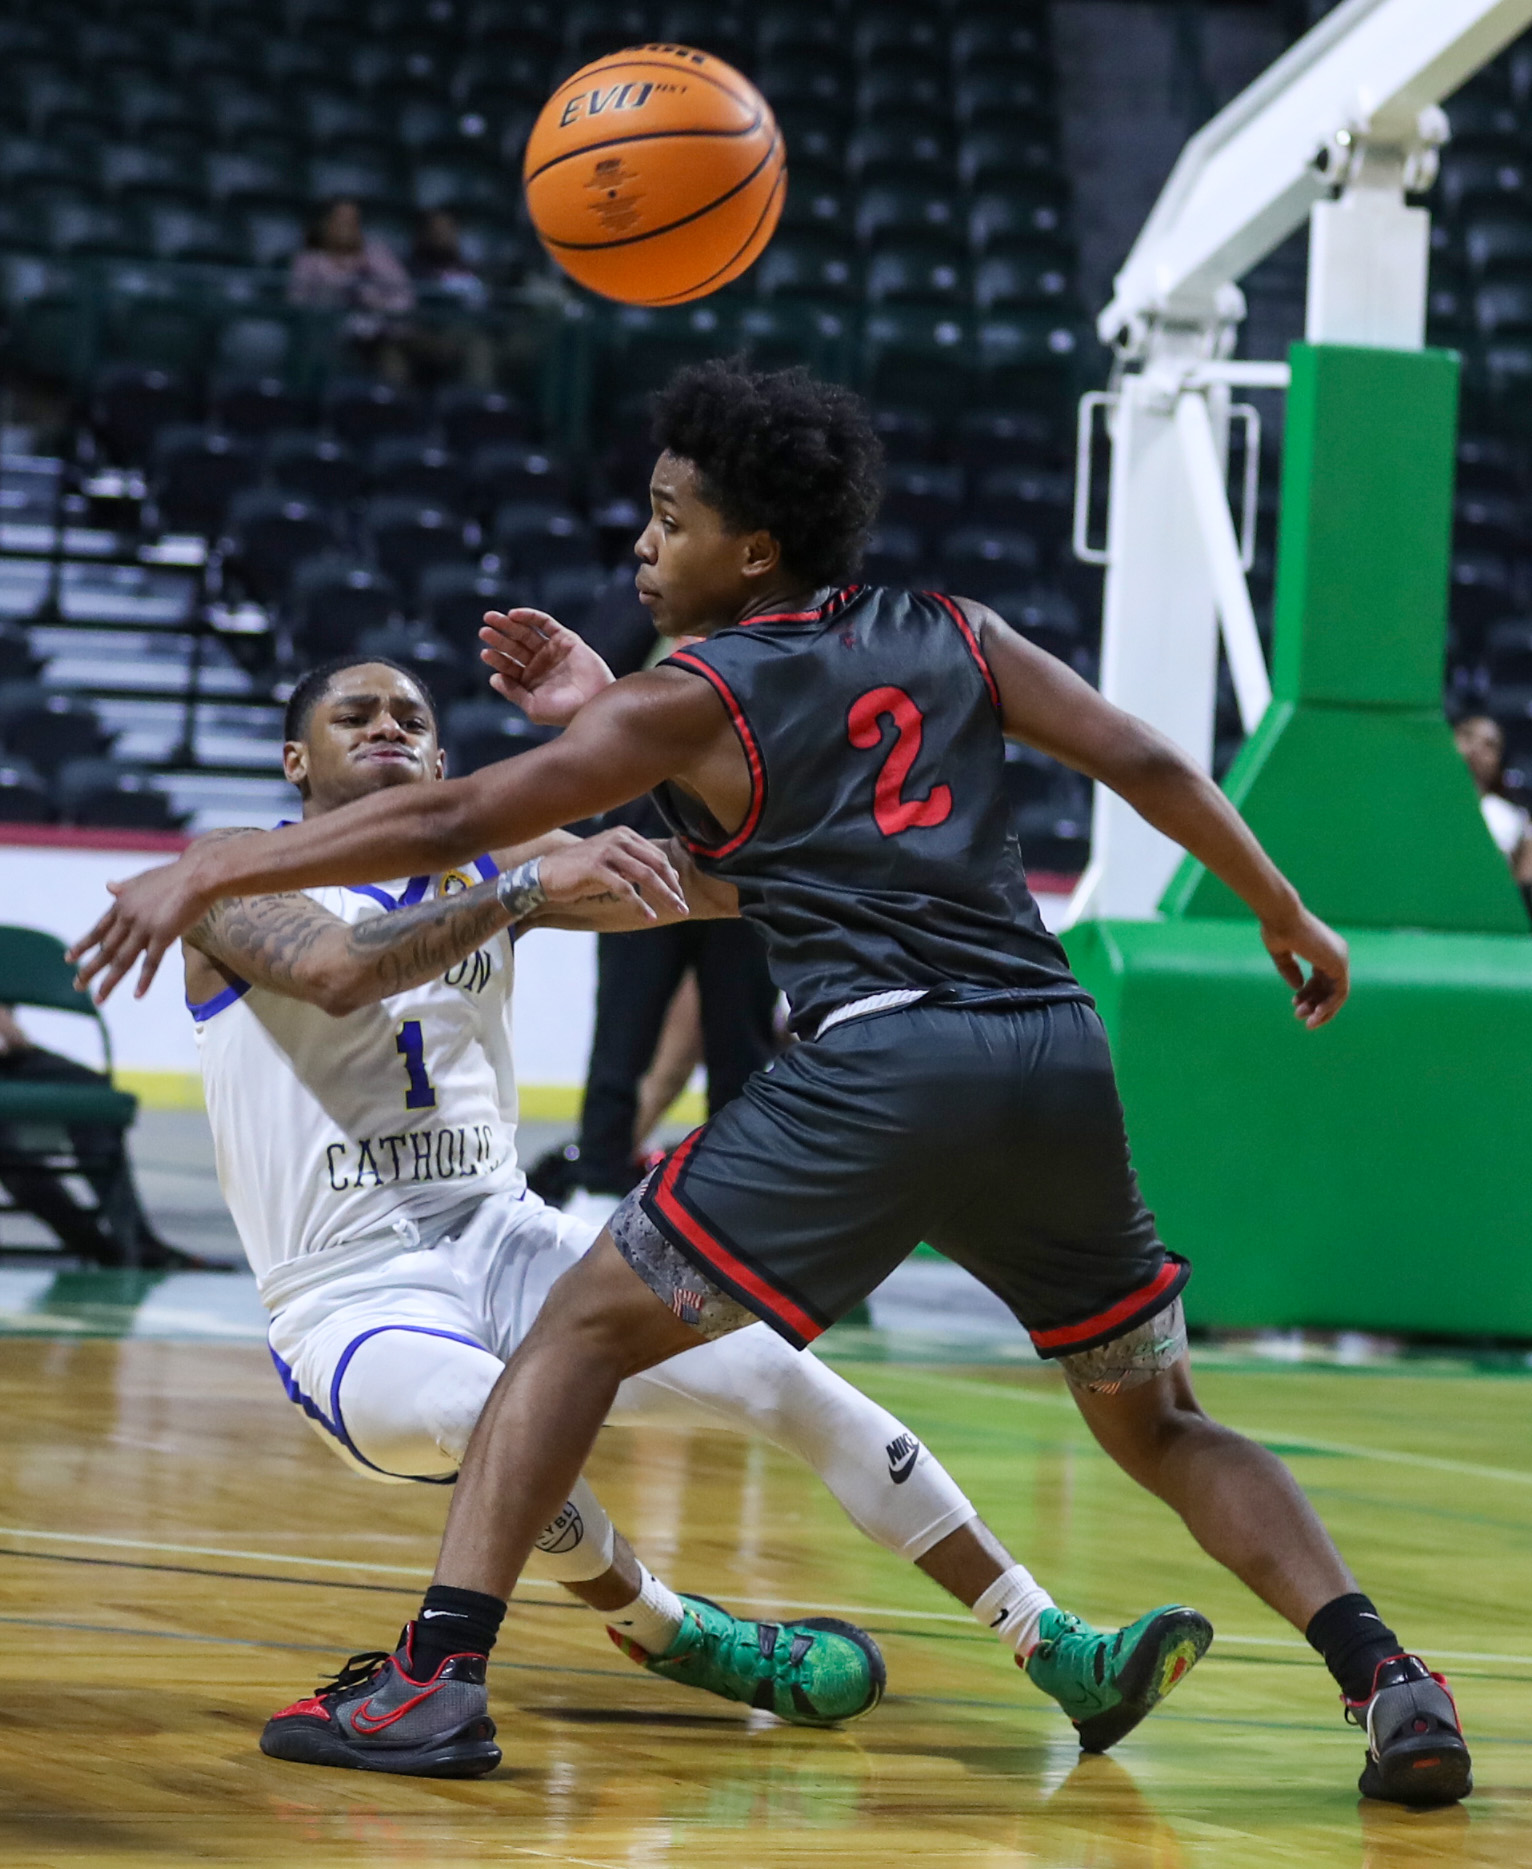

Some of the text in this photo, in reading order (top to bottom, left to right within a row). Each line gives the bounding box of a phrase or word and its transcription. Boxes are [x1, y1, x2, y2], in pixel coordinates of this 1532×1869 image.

[559, 82, 654, 128] EVO
[847, 684, 953, 838] 2
[396, 1018, 437, 1111] 1
[327, 1125, 499, 1191] CATHOLIC
[537, 1508, 573, 1540] YBL
